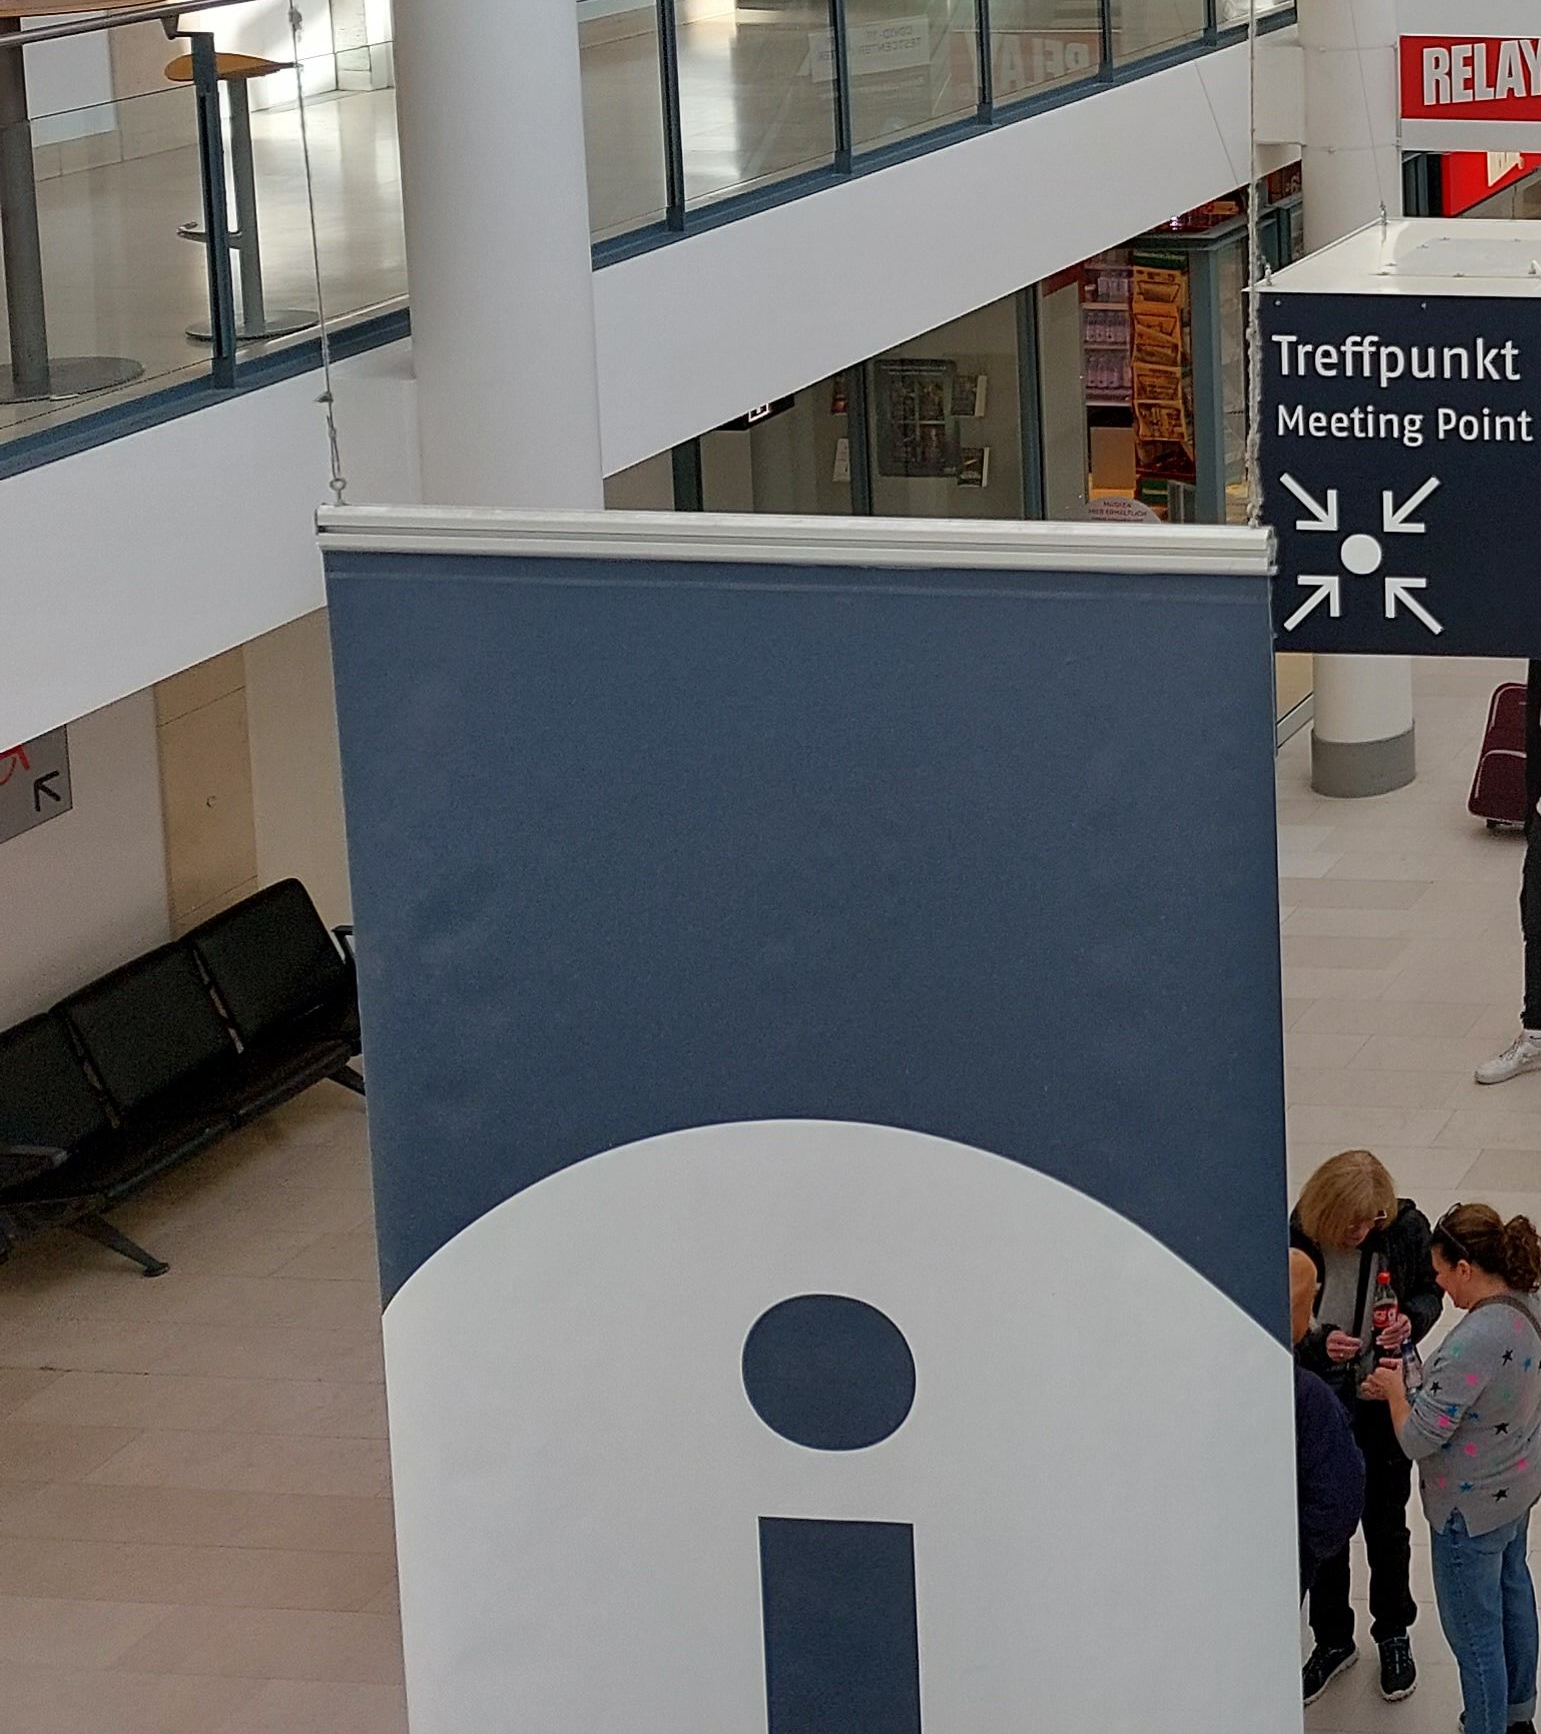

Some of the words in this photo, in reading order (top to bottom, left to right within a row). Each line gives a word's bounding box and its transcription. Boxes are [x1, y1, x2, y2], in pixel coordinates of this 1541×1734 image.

[1271, 334, 1521, 388] Treffpunkt
[1277, 404, 1423, 447] Meeting
[1438, 407, 1534, 442] Point
